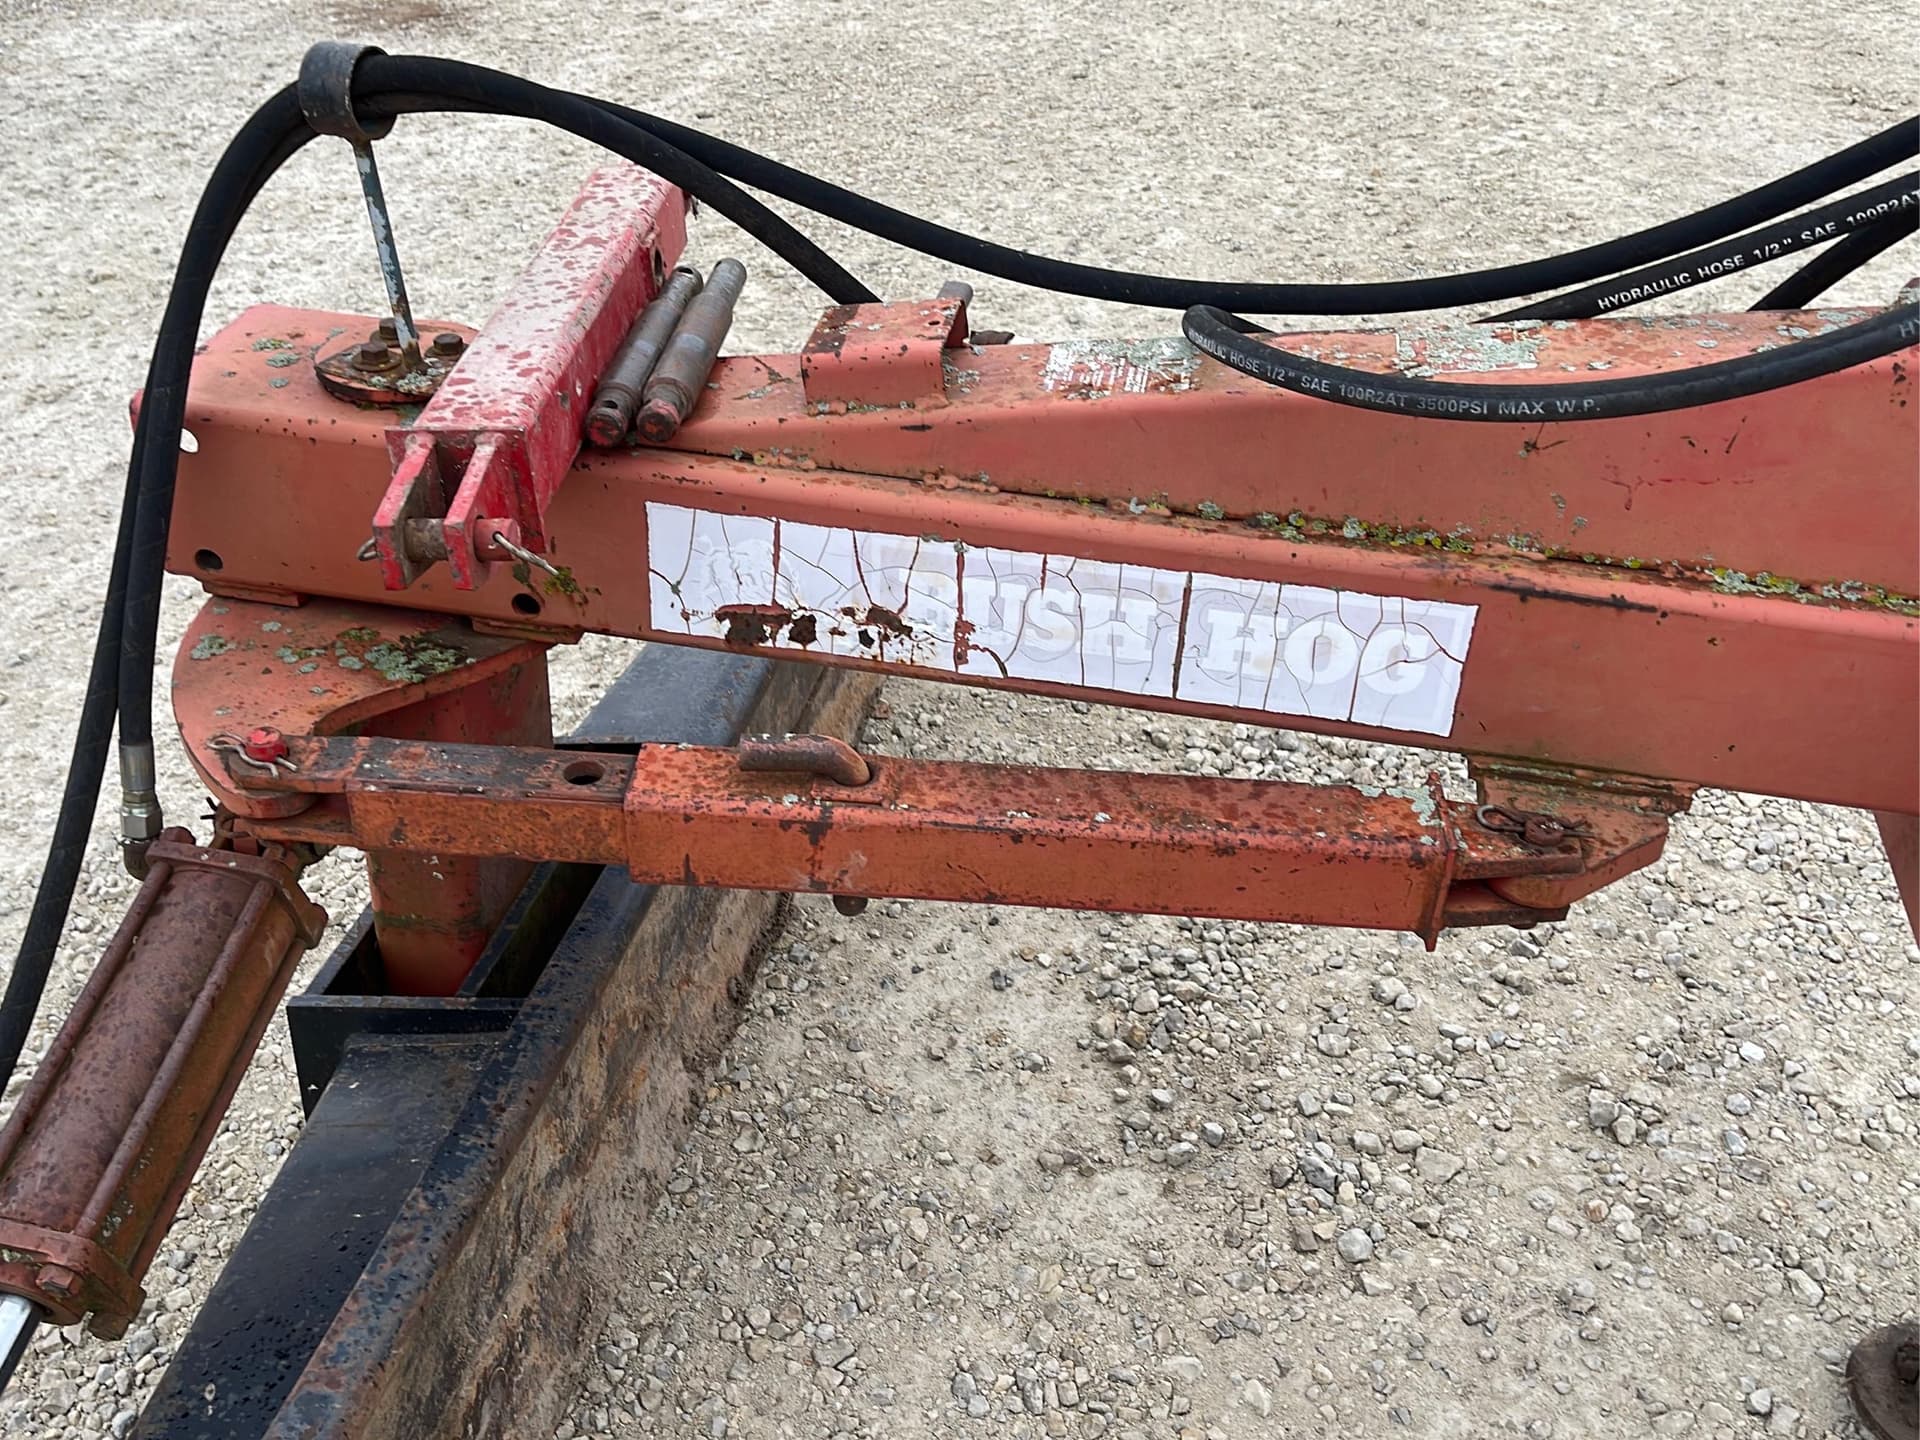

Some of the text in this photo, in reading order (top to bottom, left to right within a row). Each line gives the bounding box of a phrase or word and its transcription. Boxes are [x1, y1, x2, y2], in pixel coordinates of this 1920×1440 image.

[1597, 272, 1692, 310] HYDRAULIC
[1698, 253, 1745, 279] HOSE
[1753, 237, 1792, 260] 1/2"
[1801, 221, 1837, 244] SAE
[1230, 350, 1260, 374] HOSE
[1266, 364, 1295, 382] 1/2"
[1301, 375, 1331, 393] SAE
[1339, 383, 1408, 408] 100R2AT
[1416, 396, 1488, 414] 3500PSI
[1498, 400, 1545, 415] MAX
[1556, 398, 1601, 414] W.P.
[1202, 608, 1429, 695] HOG
